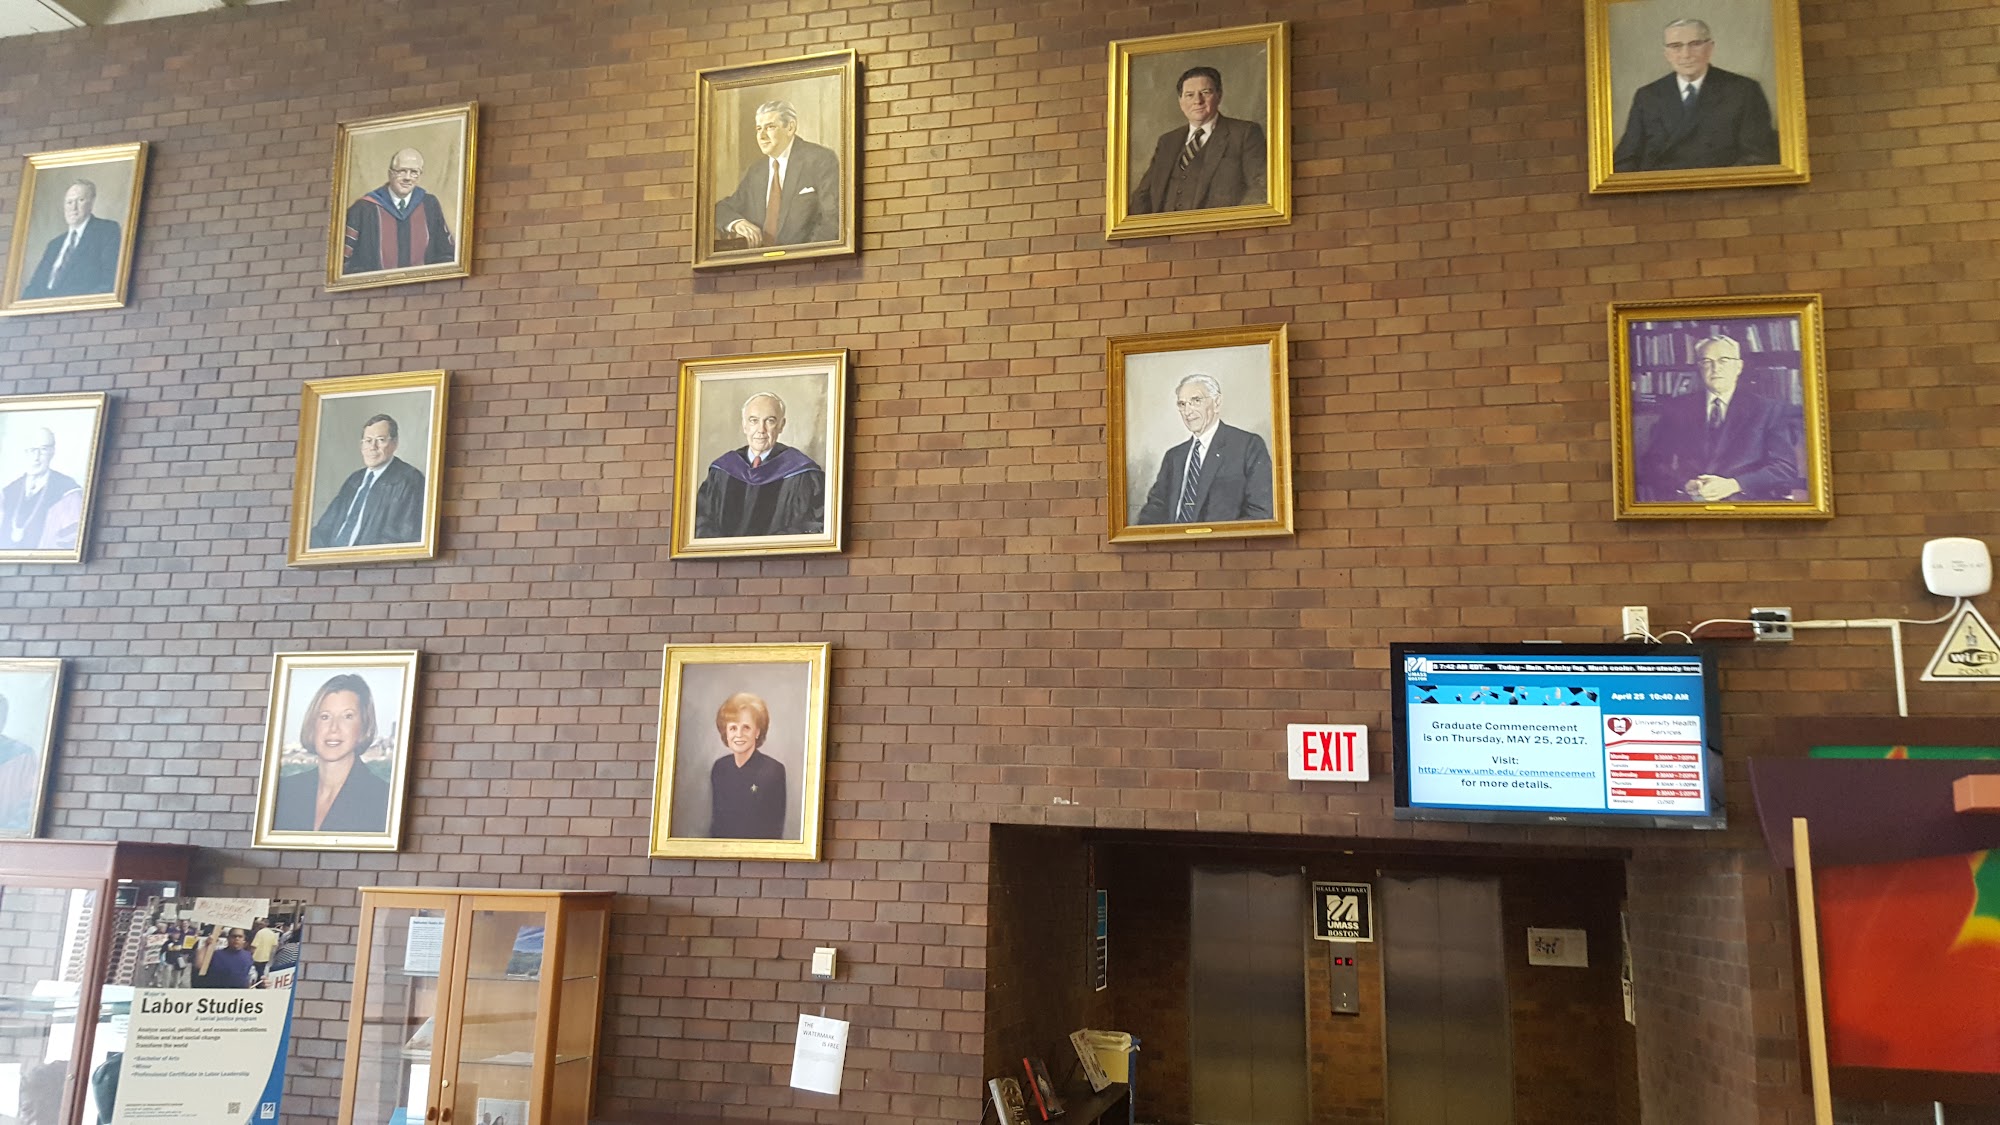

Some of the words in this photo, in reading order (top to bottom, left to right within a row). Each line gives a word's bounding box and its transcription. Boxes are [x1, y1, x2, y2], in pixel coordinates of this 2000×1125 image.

[1497, 663, 1520, 672] Today
[1545, 664, 1571, 672] Patchy
[1656, 665, 1682, 673] steady
[1611, 693, 1633, 701] April
[1649, 693, 1673, 701] 10:40
[1674, 693, 1690, 701] AM
[1431, 721, 1483, 731] Graduate
[1485, 722, 1578, 732] Commencement
[1634, 719, 1670, 728] University
[1423, 733, 1432, 742] is
[1452, 733, 1504, 744] Thursday,
[1506, 735, 1531, 744] MAY
[1534, 735, 1553, 745] 25,
[1555, 736, 1588, 745] 2017.
[1302, 731, 1357, 772] EXIT
[1491, 755, 1519, 765] Visit:
[1417, 765, 1596, 778] http://www.umb.edu/commencement
[1461, 778, 1476, 787] for
[1479, 780, 1509, 788] more
[1511, 780, 1553, 789] details.
[1327, 921, 1360, 930] UMASS
[1327, 929, 1360, 938] BOSTON
[141, 997, 193, 1014] Labor
[196, 998, 264, 1014] Studies
[804, 1021, 814, 1029] THE
[802, 1030, 835, 1040] WATERMARK
[827, 1042, 840, 1050] FREE
